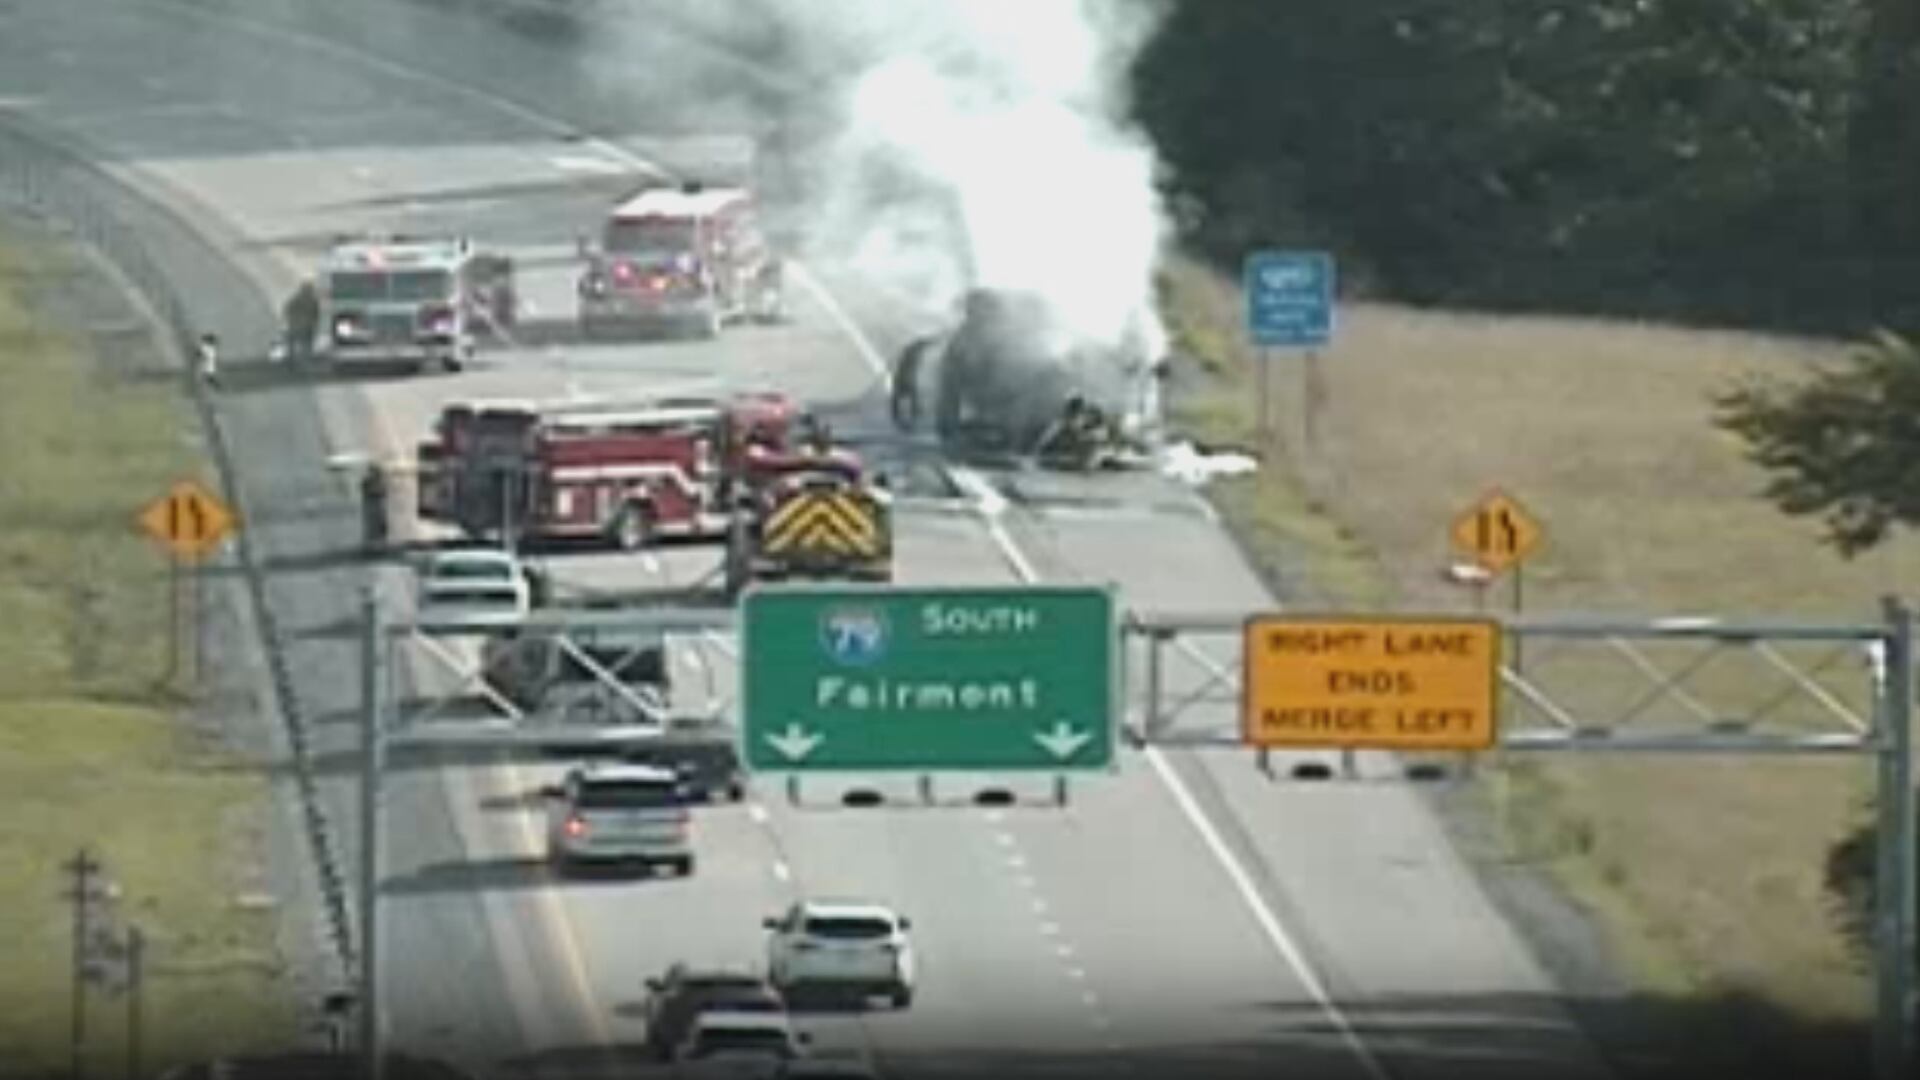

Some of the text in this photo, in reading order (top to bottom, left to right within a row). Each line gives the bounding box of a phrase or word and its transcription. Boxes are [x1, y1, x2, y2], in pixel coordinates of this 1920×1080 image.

[1267, 630, 1475, 656] RIGHT LANE
[816, 676, 1037, 709] Fairmont
[1328, 670, 1417, 694] ENDS
[1262, 707, 1475, 732] MERGE LEFT
